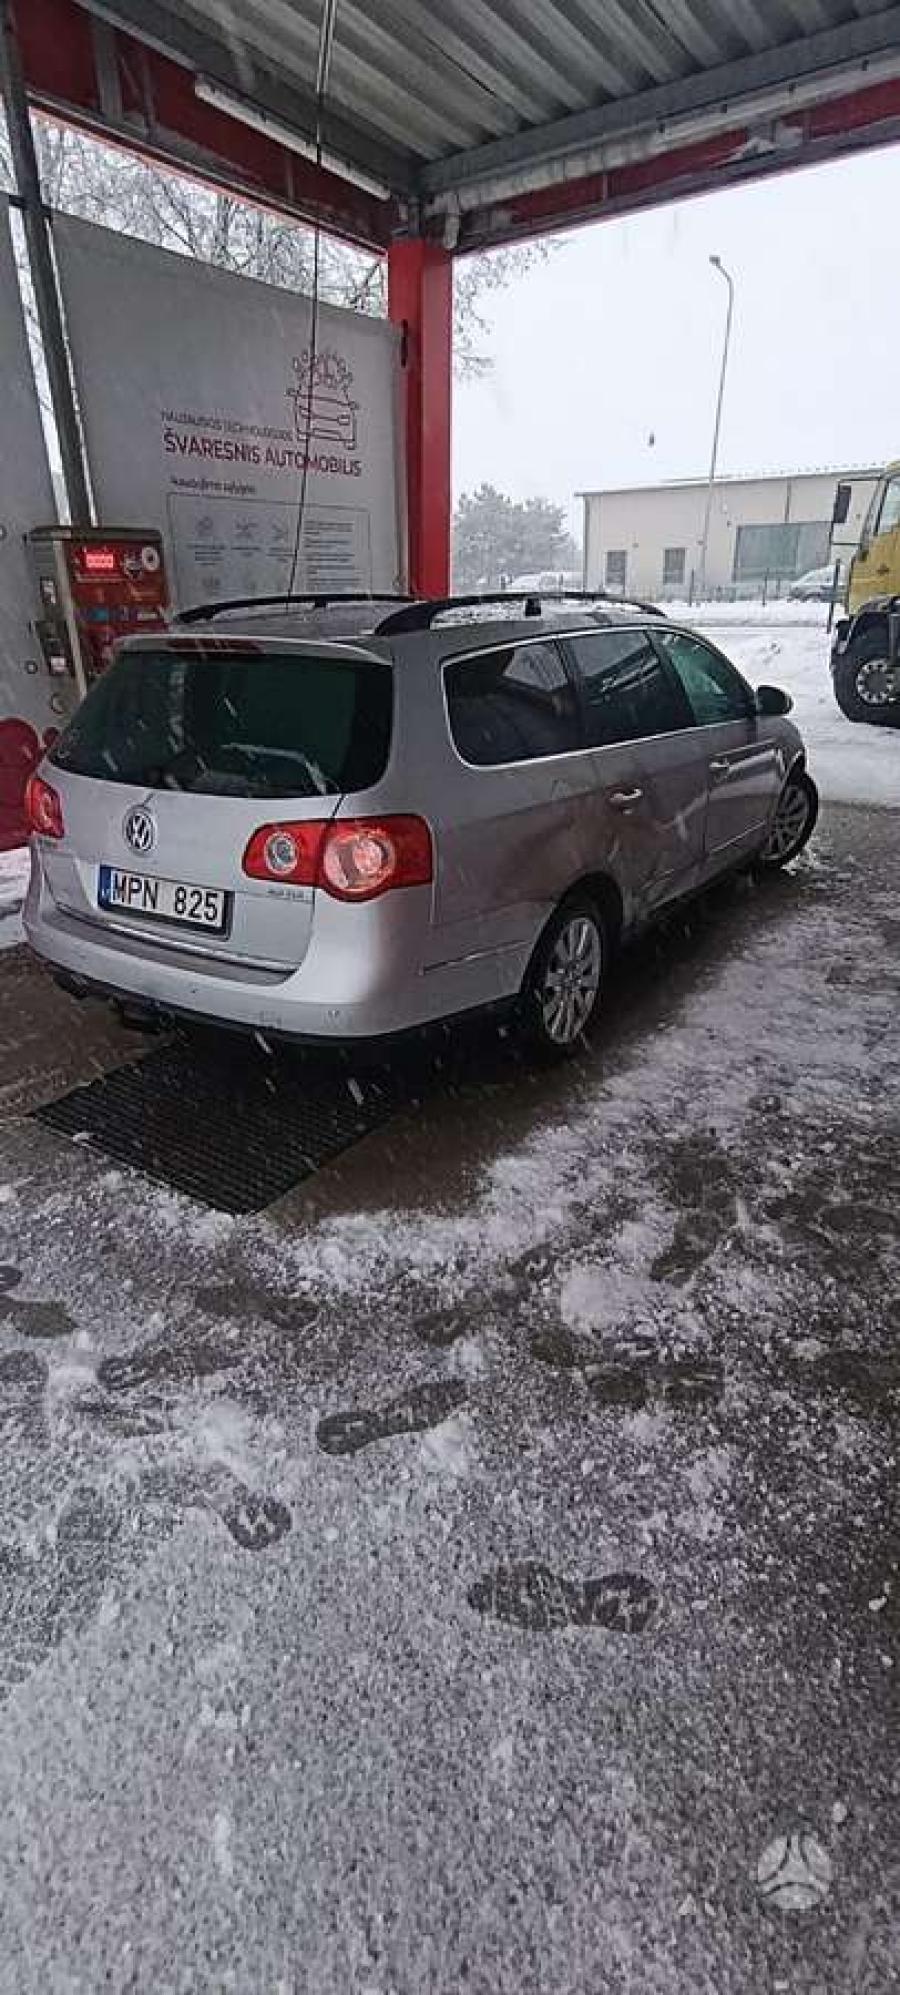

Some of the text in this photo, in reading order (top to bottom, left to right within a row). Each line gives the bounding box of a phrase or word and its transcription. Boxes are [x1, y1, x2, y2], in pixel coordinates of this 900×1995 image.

[163, 427, 362, 477] ŠVARESNIS AUTOMOBILIS
[112, 871, 159, 910] MPN
[173, 885, 219, 921] 825
